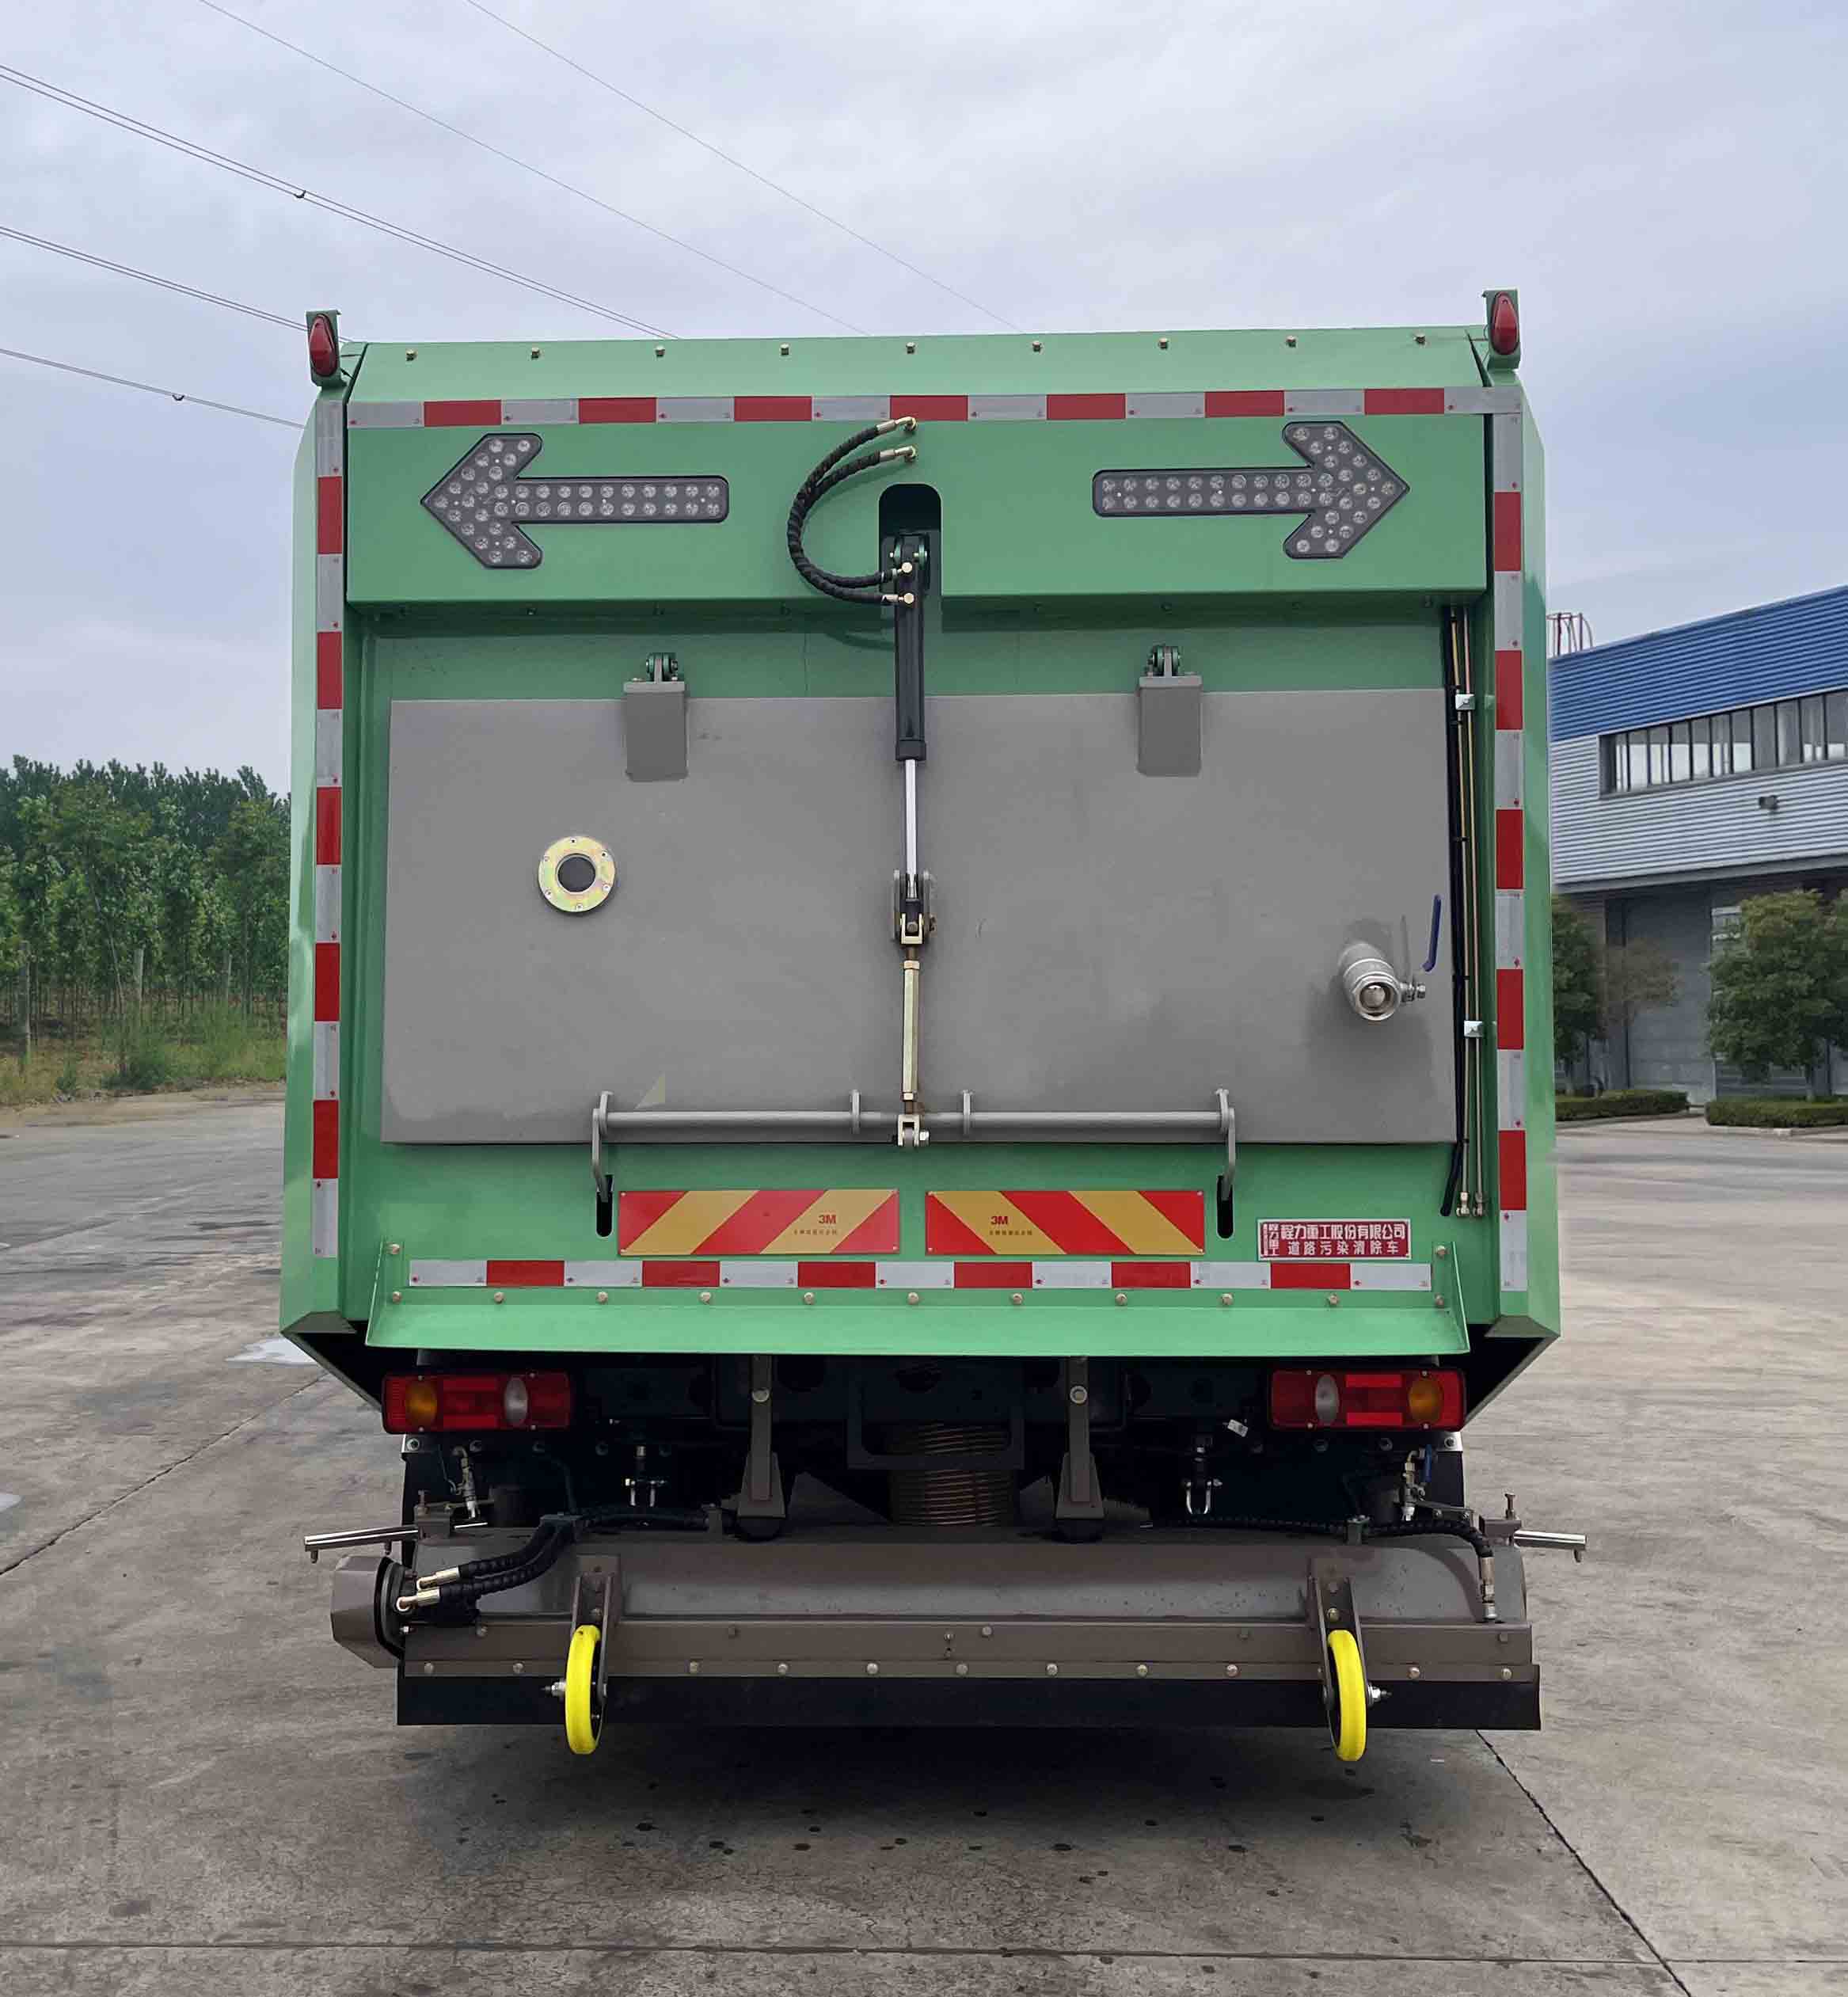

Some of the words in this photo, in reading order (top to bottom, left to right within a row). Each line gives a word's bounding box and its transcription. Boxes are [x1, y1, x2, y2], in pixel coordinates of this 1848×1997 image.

[818, 1214, 836, 1224] 3M
[990, 1215, 1008, 1225] 3M
[1280, 1224, 1405, 1240] 程力重工股份有限公司
